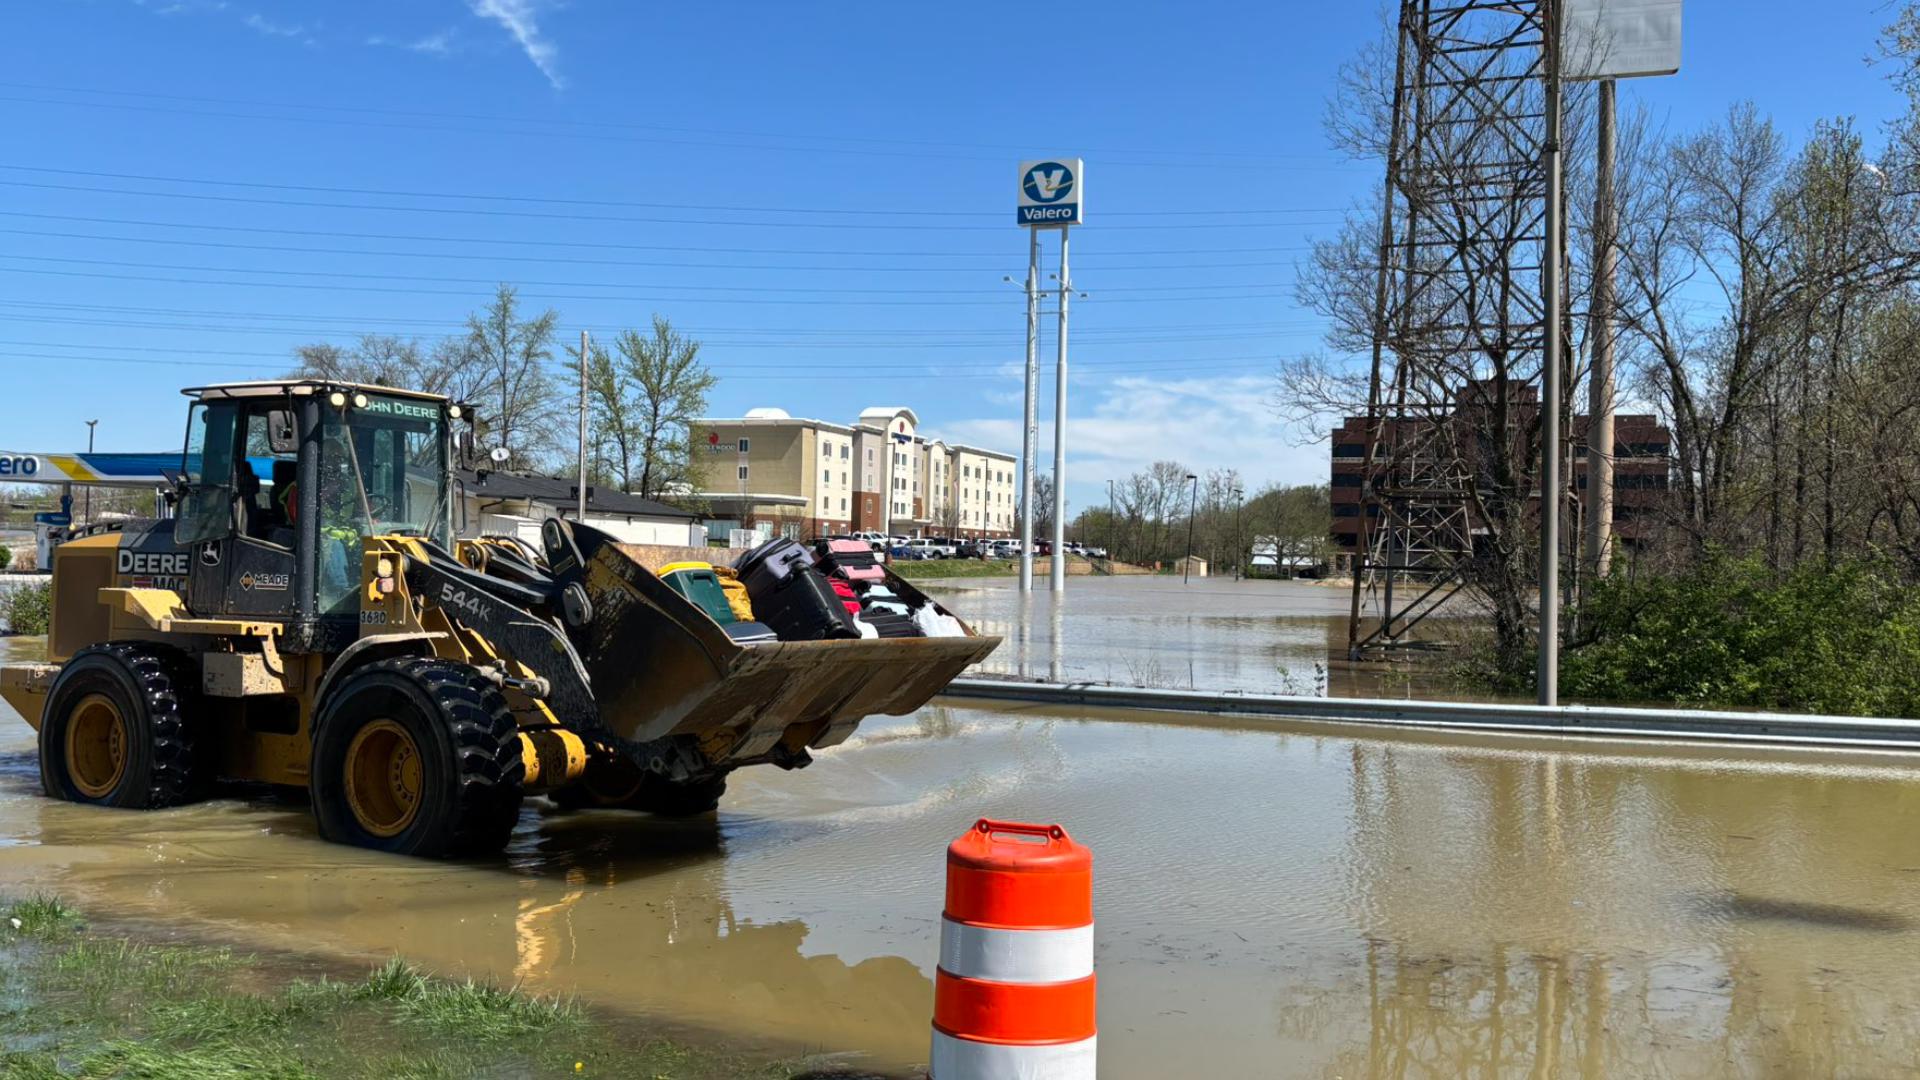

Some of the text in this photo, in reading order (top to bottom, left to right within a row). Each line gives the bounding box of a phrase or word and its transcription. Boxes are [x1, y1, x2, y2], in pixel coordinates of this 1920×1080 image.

[1024, 207, 1072, 220] Valero
[394, 402, 438, 419] DEERE
[118, 549, 189, 574] DEERE
[255, 573, 289, 585] MEADE
[440, 582, 492, 622] 544K
